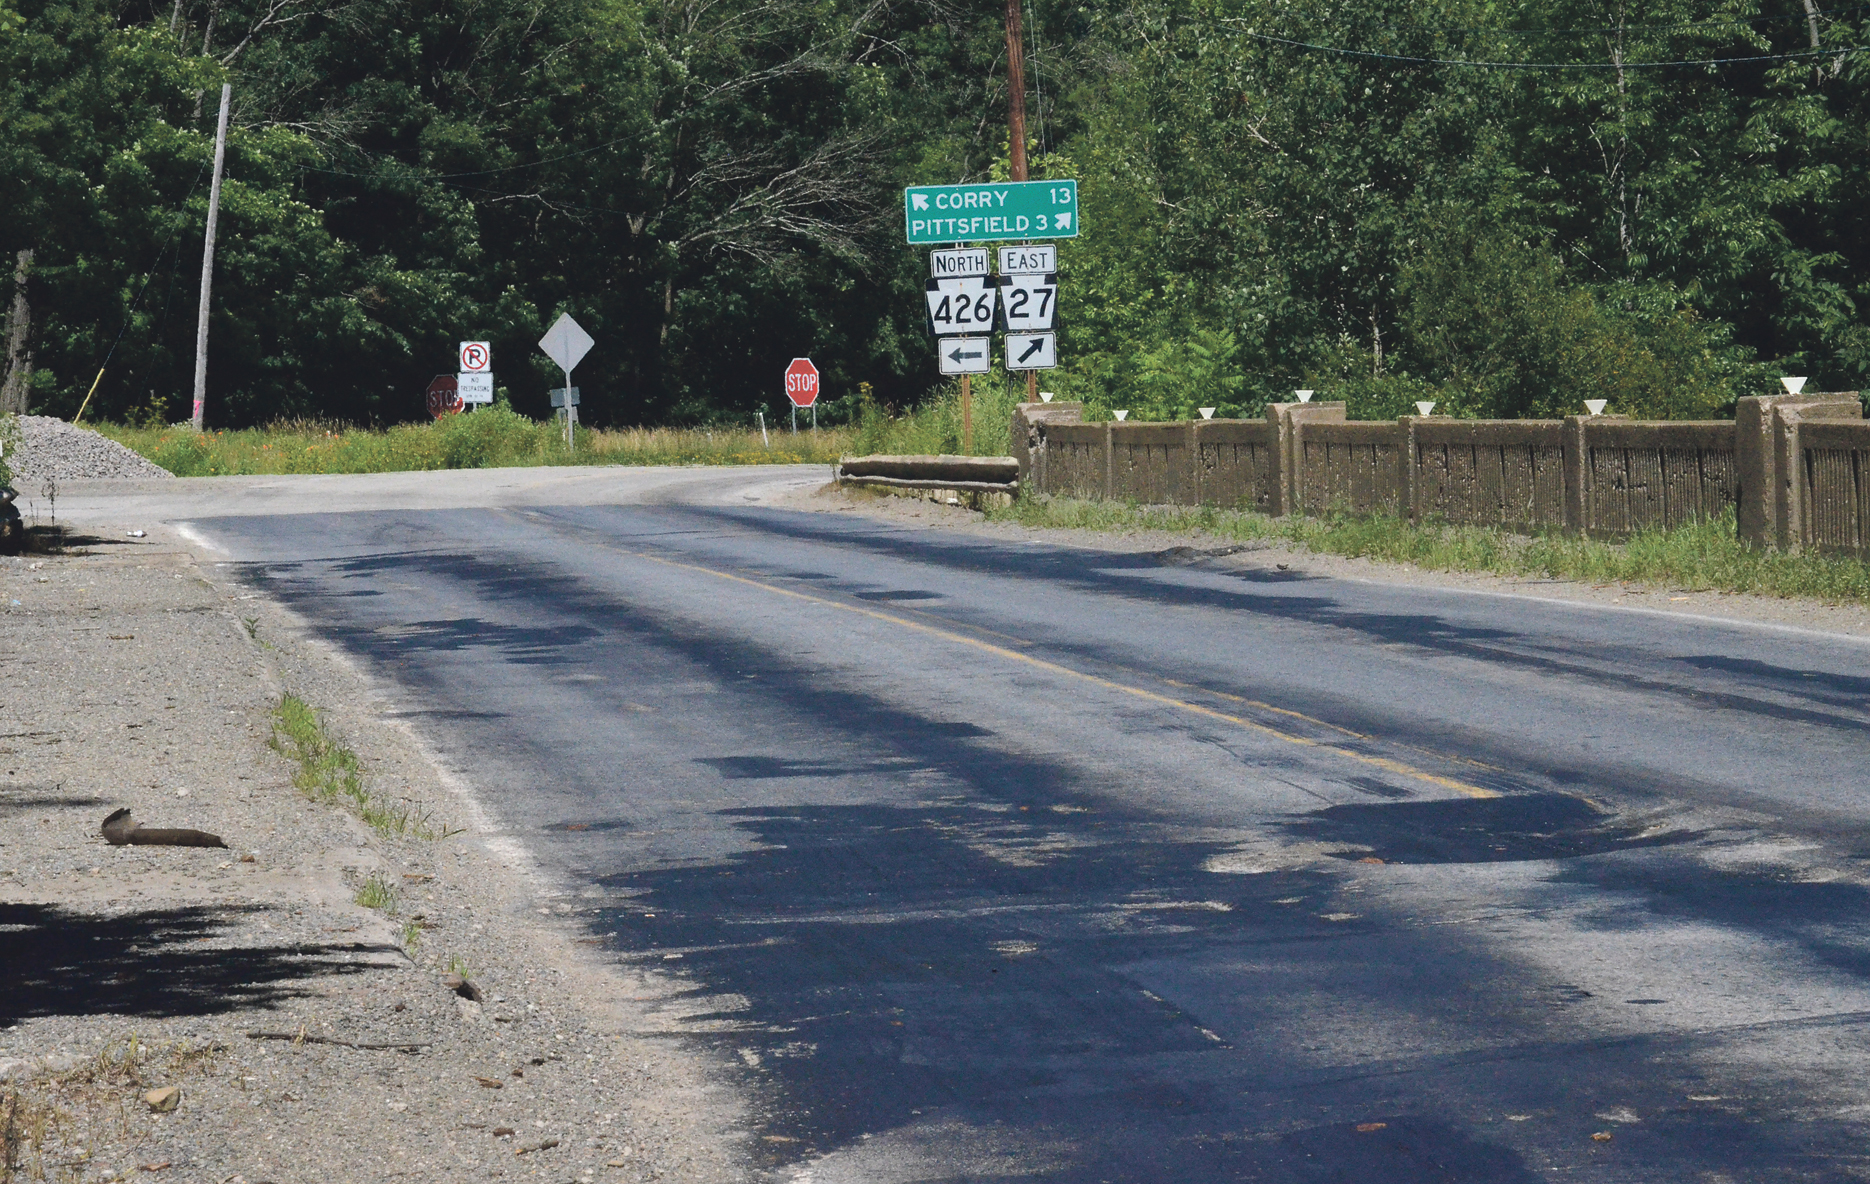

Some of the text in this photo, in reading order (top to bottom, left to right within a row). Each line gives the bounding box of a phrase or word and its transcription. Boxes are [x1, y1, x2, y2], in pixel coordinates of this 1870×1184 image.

[936, 187, 1071, 209] CORRY 13
[912, 214, 1048, 236] PITTSFIELD 3
[936, 255, 984, 273] NORTH
[1007, 251, 1048, 270] EAST
[934, 292, 991, 324] 426
[1009, 288, 1053, 319] 27
[788, 373, 817, 392] STOP
